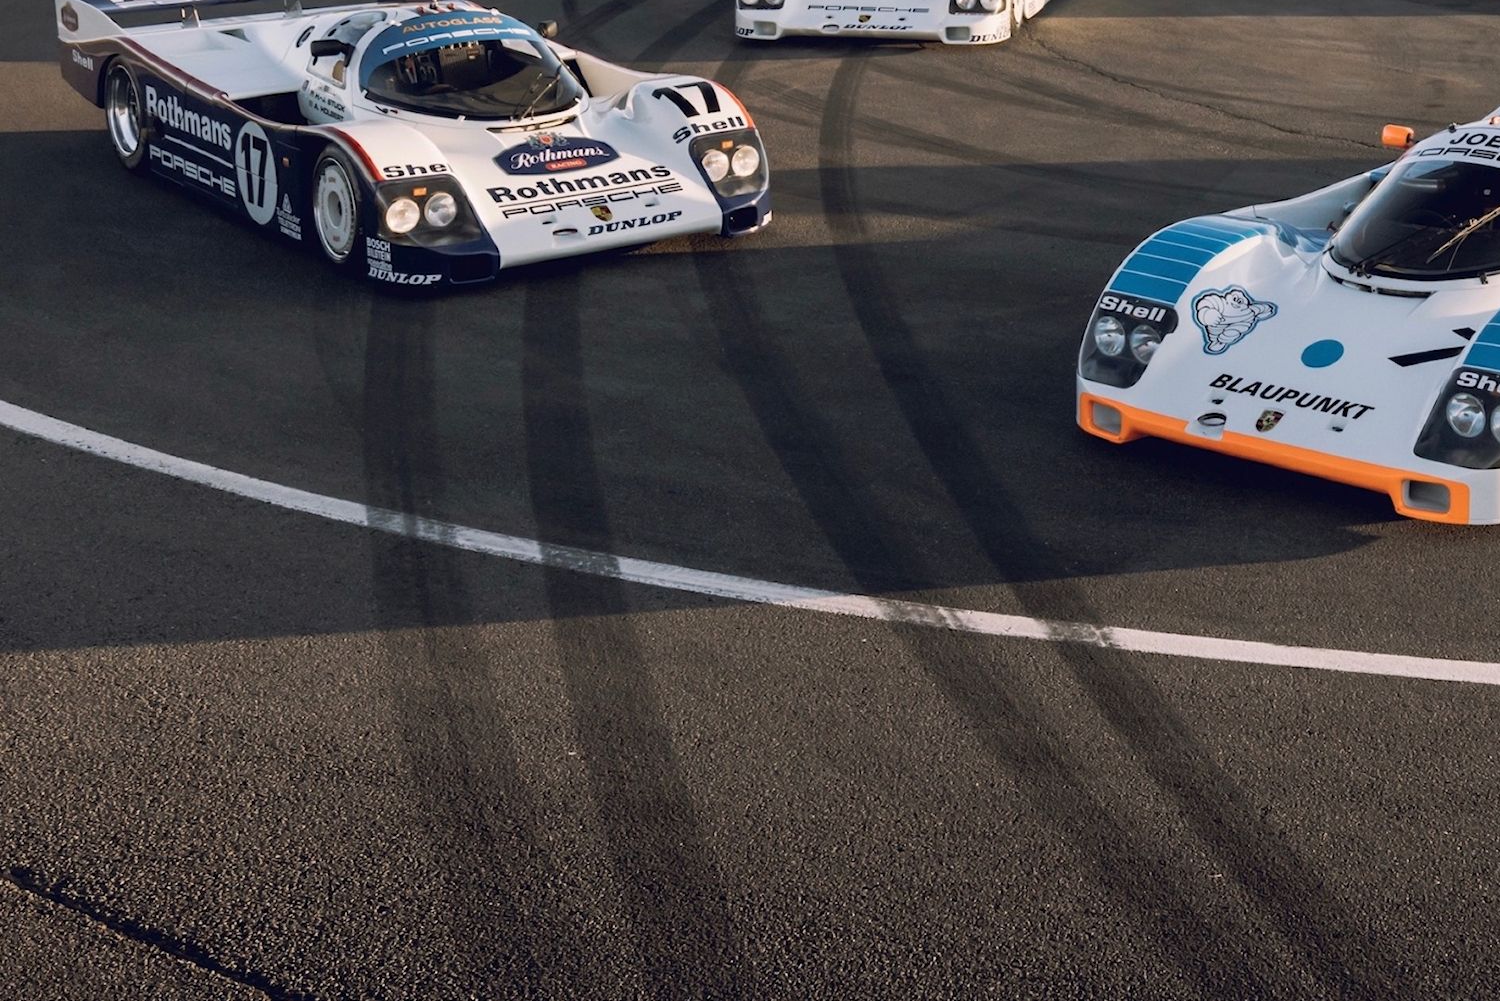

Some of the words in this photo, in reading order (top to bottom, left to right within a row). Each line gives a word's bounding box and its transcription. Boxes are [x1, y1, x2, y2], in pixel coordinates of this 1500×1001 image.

[808, 4, 930, 13] PORSCHE
[403, 16, 503, 34] AUTOGLASS
[383, 27, 531, 55] PORSCHE
[73, 49, 94, 71] Shell
[651, 81, 720, 118] 17
[145, 85, 232, 151] Rothmans
[673, 116, 745, 144] Shell
[149, 144, 237, 198] PORSCHE
[242, 132, 268, 208] 17
[511, 146, 610, 170] Rothmans
[486, 165, 672, 203] Rothmans
[502, 183, 684, 219] PORSCHE
[588, 211, 683, 236] DUNLOP
[366, 237, 391, 252] BOSCH
[367, 267, 442, 286] DUNLOP
[1099, 295, 1167, 322] Shell
[1209, 373, 1376, 420] BLAUPUNKT
